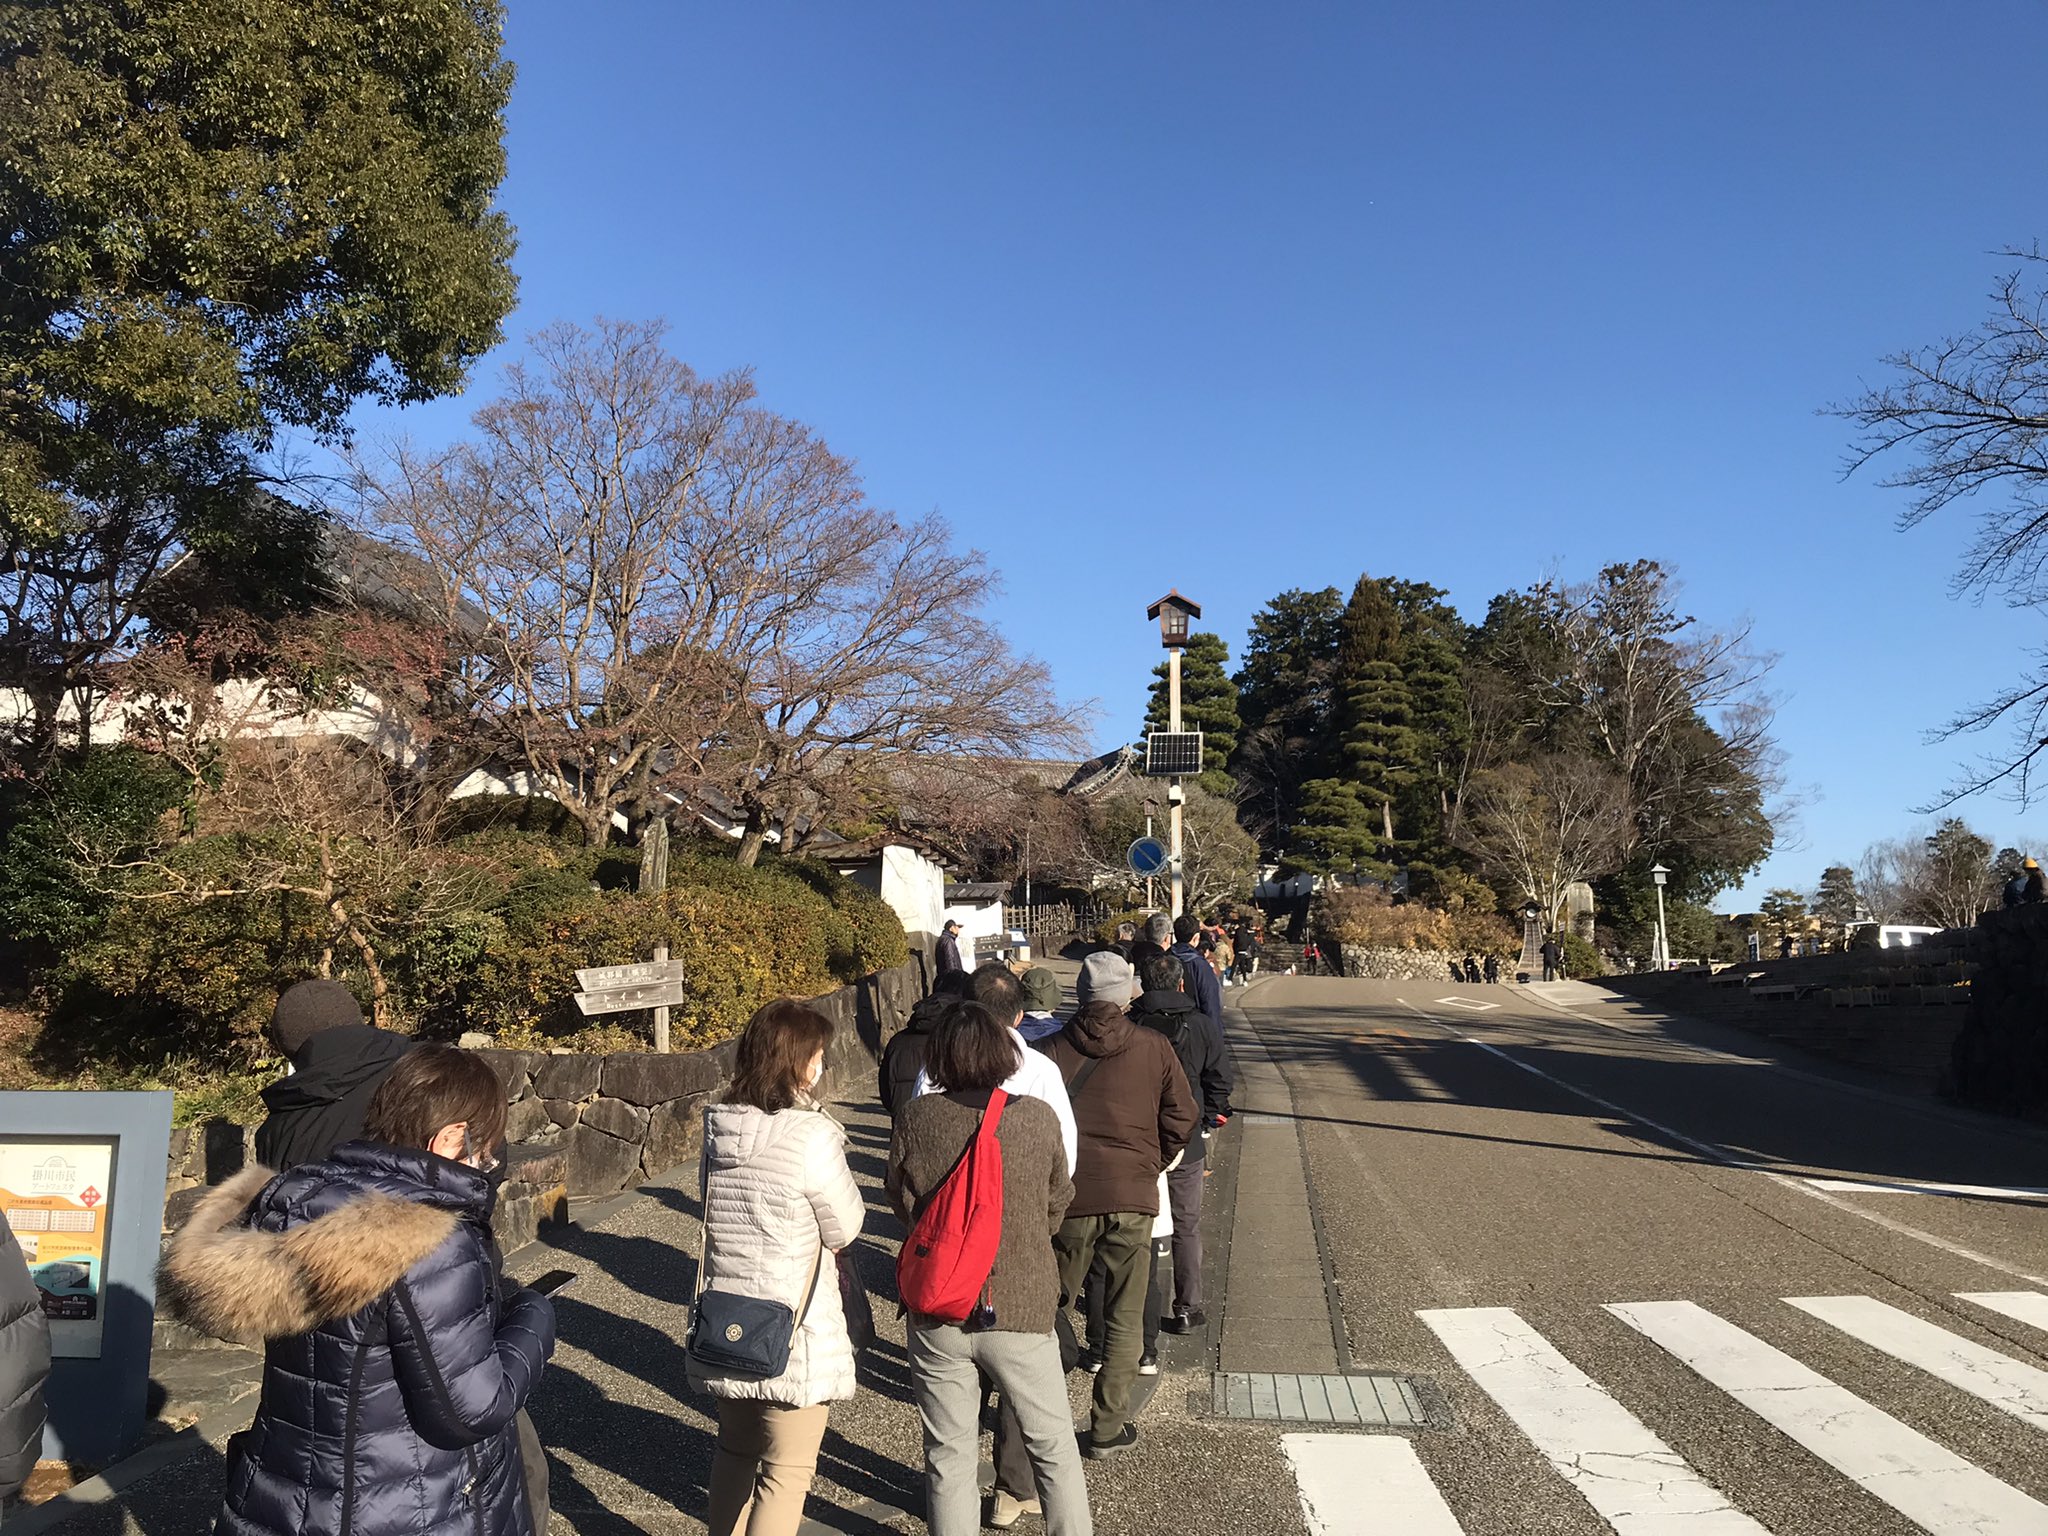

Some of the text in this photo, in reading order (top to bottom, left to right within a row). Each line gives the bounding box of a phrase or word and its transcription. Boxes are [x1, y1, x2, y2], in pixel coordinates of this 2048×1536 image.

[604, 991, 644, 1003] トイレ
[32, 1169, 76, 1182] 掛川市民
